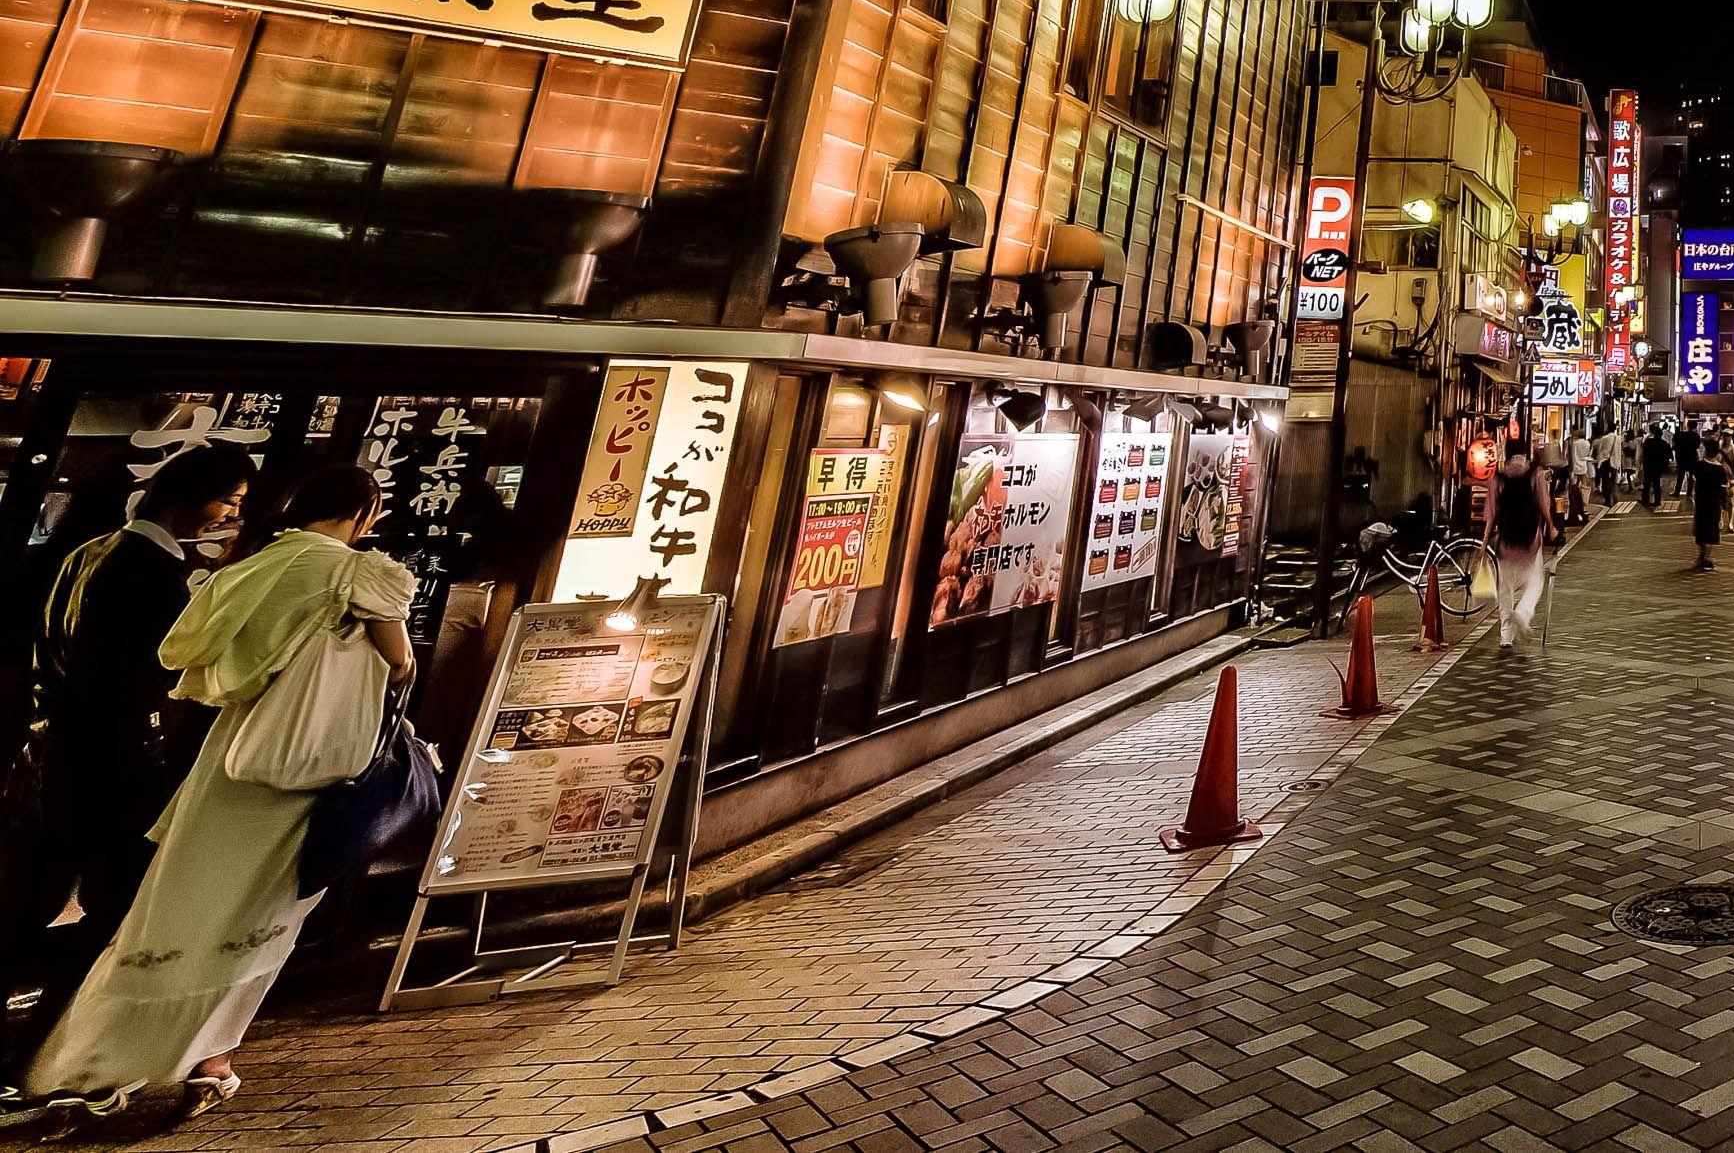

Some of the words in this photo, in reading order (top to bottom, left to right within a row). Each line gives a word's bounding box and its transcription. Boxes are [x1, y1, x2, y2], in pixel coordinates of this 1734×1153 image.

[1612, 119, 1631, 194] 歌広場
[1308, 187, 1352, 239] P
[1306, 253, 1340, 265] パーク
[1310, 266, 1343, 278] NET
[1609, 218, 1630, 345] カラオケ&ティー
[1300, 292, 1340, 313] ¥100
[1687, 337, 1713, 392] 庄や
[605, 371, 657, 483] ホッピー
[647, 368, 735, 588] ココが和牛
[817, 456, 868, 492] 早得
[1001, 463, 1038, 488] ココが
[971, 499, 1052, 540] 和牛ホルモン
[793, 543, 858, 590] 200円
